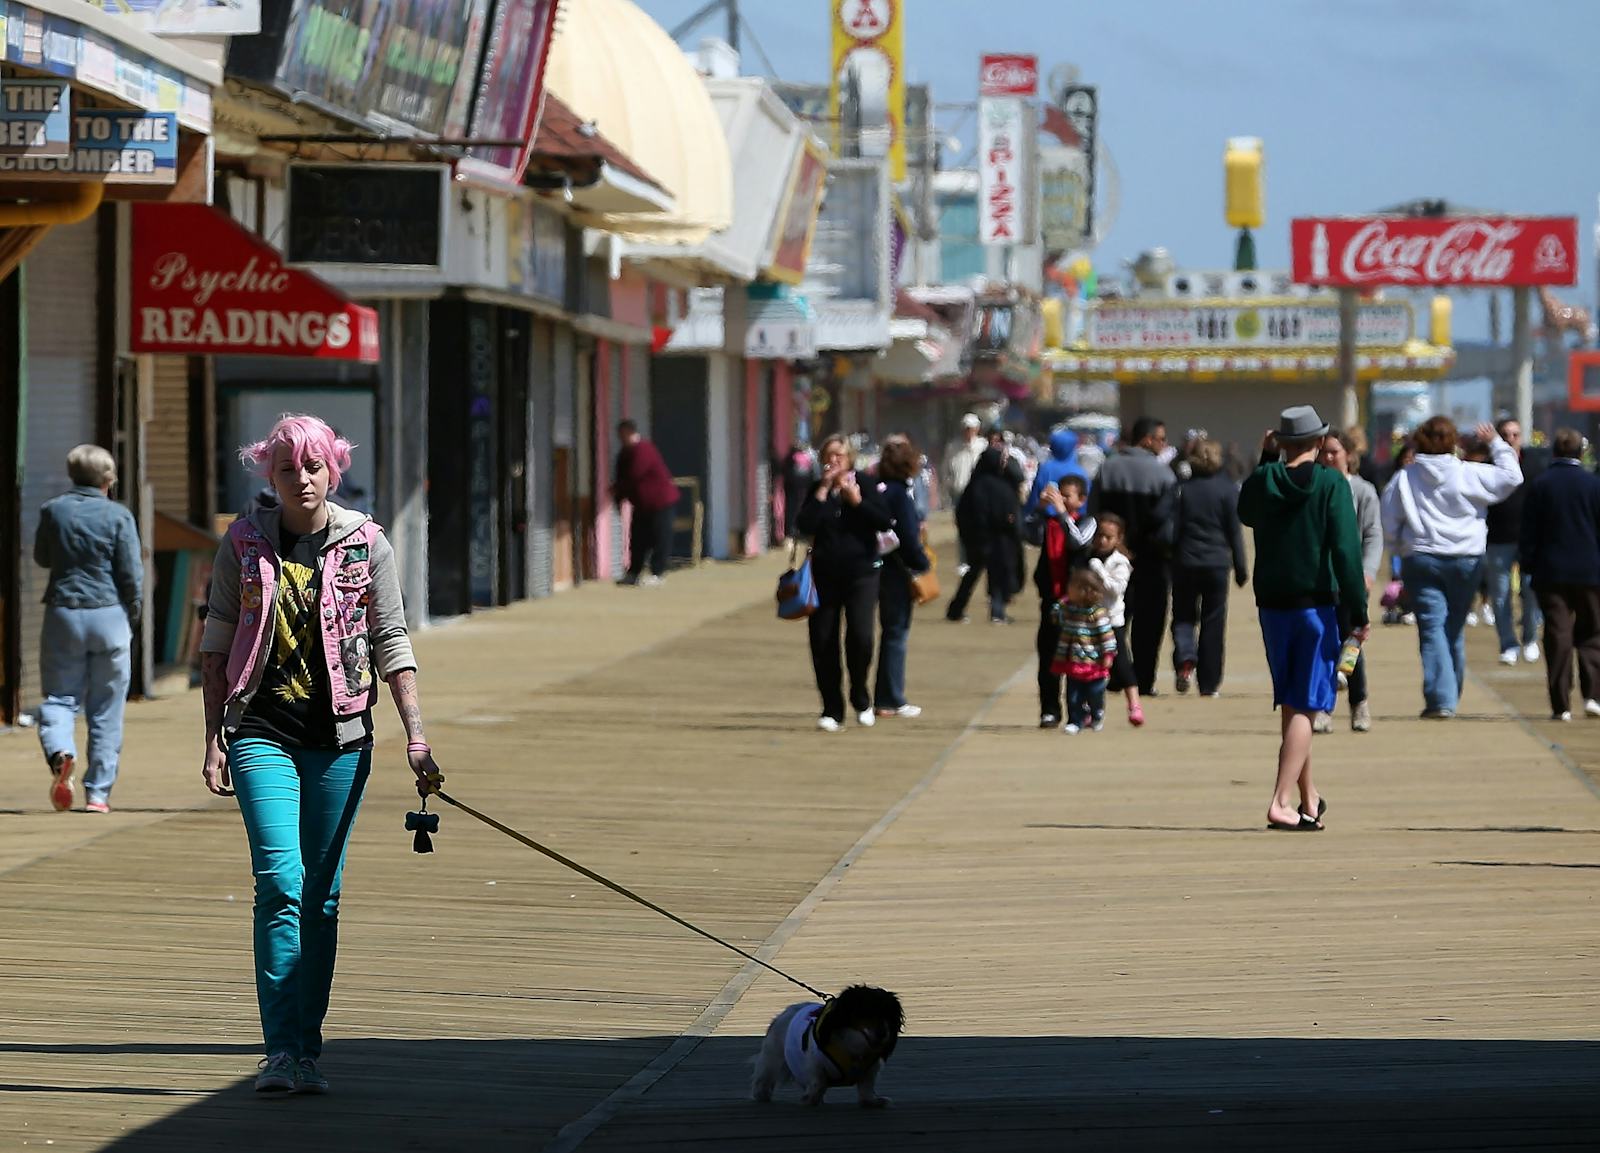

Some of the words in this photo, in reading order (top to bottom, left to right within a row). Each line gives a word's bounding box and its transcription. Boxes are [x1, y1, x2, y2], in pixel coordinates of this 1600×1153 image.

[5, 86, 60, 111] THE
[76, 117, 112, 140] TO
[117, 117, 169, 141] THE
[985, 149, 1013, 238] PIZZA
[151, 252, 289, 304] Psychic
[141, 307, 351, 348] READINGS
